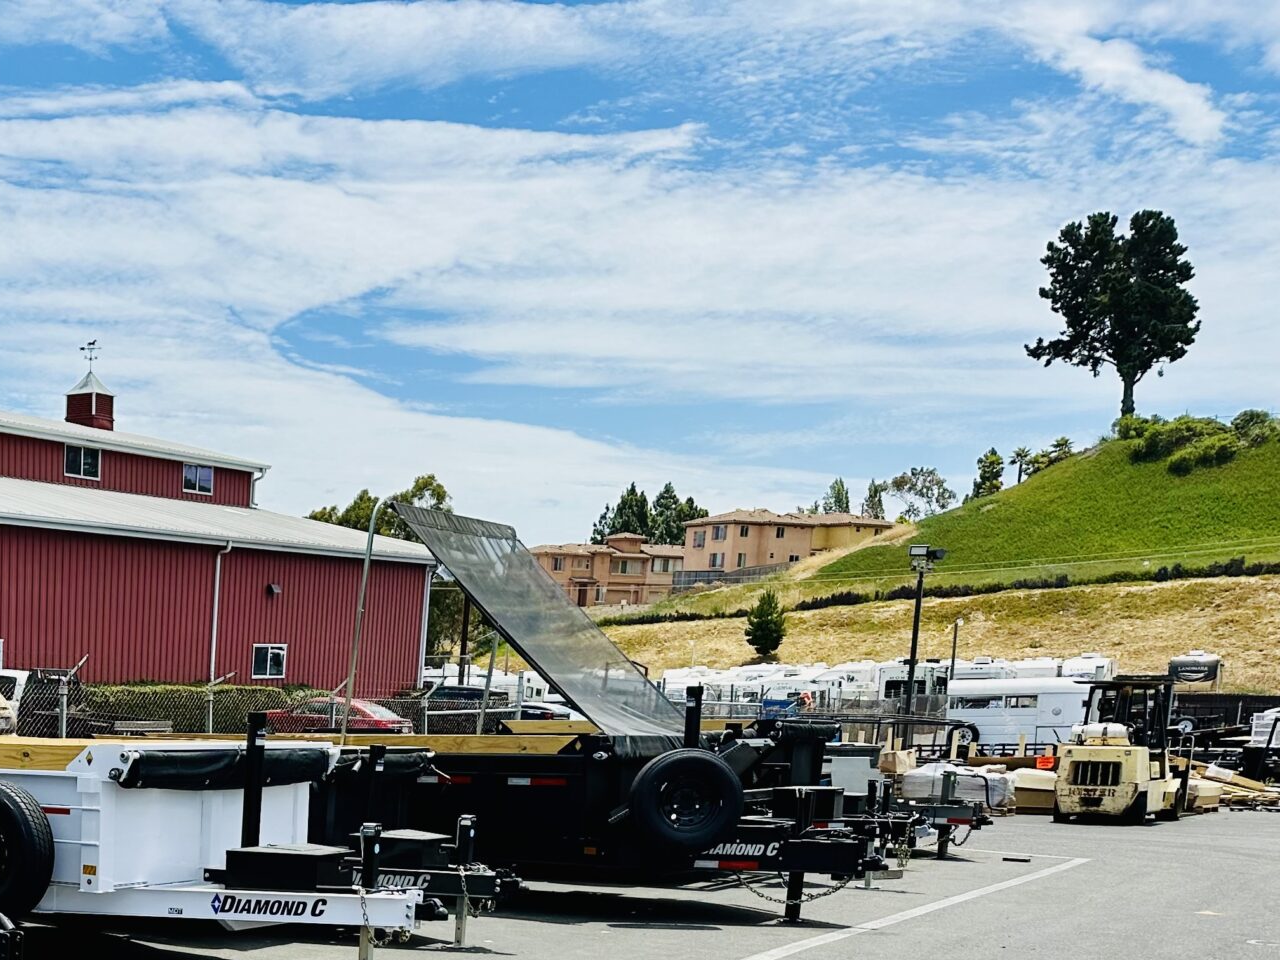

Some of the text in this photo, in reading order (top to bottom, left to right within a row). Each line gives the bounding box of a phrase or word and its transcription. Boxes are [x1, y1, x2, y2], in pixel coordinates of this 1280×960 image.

[701, 842, 779, 856] AMOND C
[417, 873, 431, 889] C
[220, 895, 328, 917] DIAMOND C
